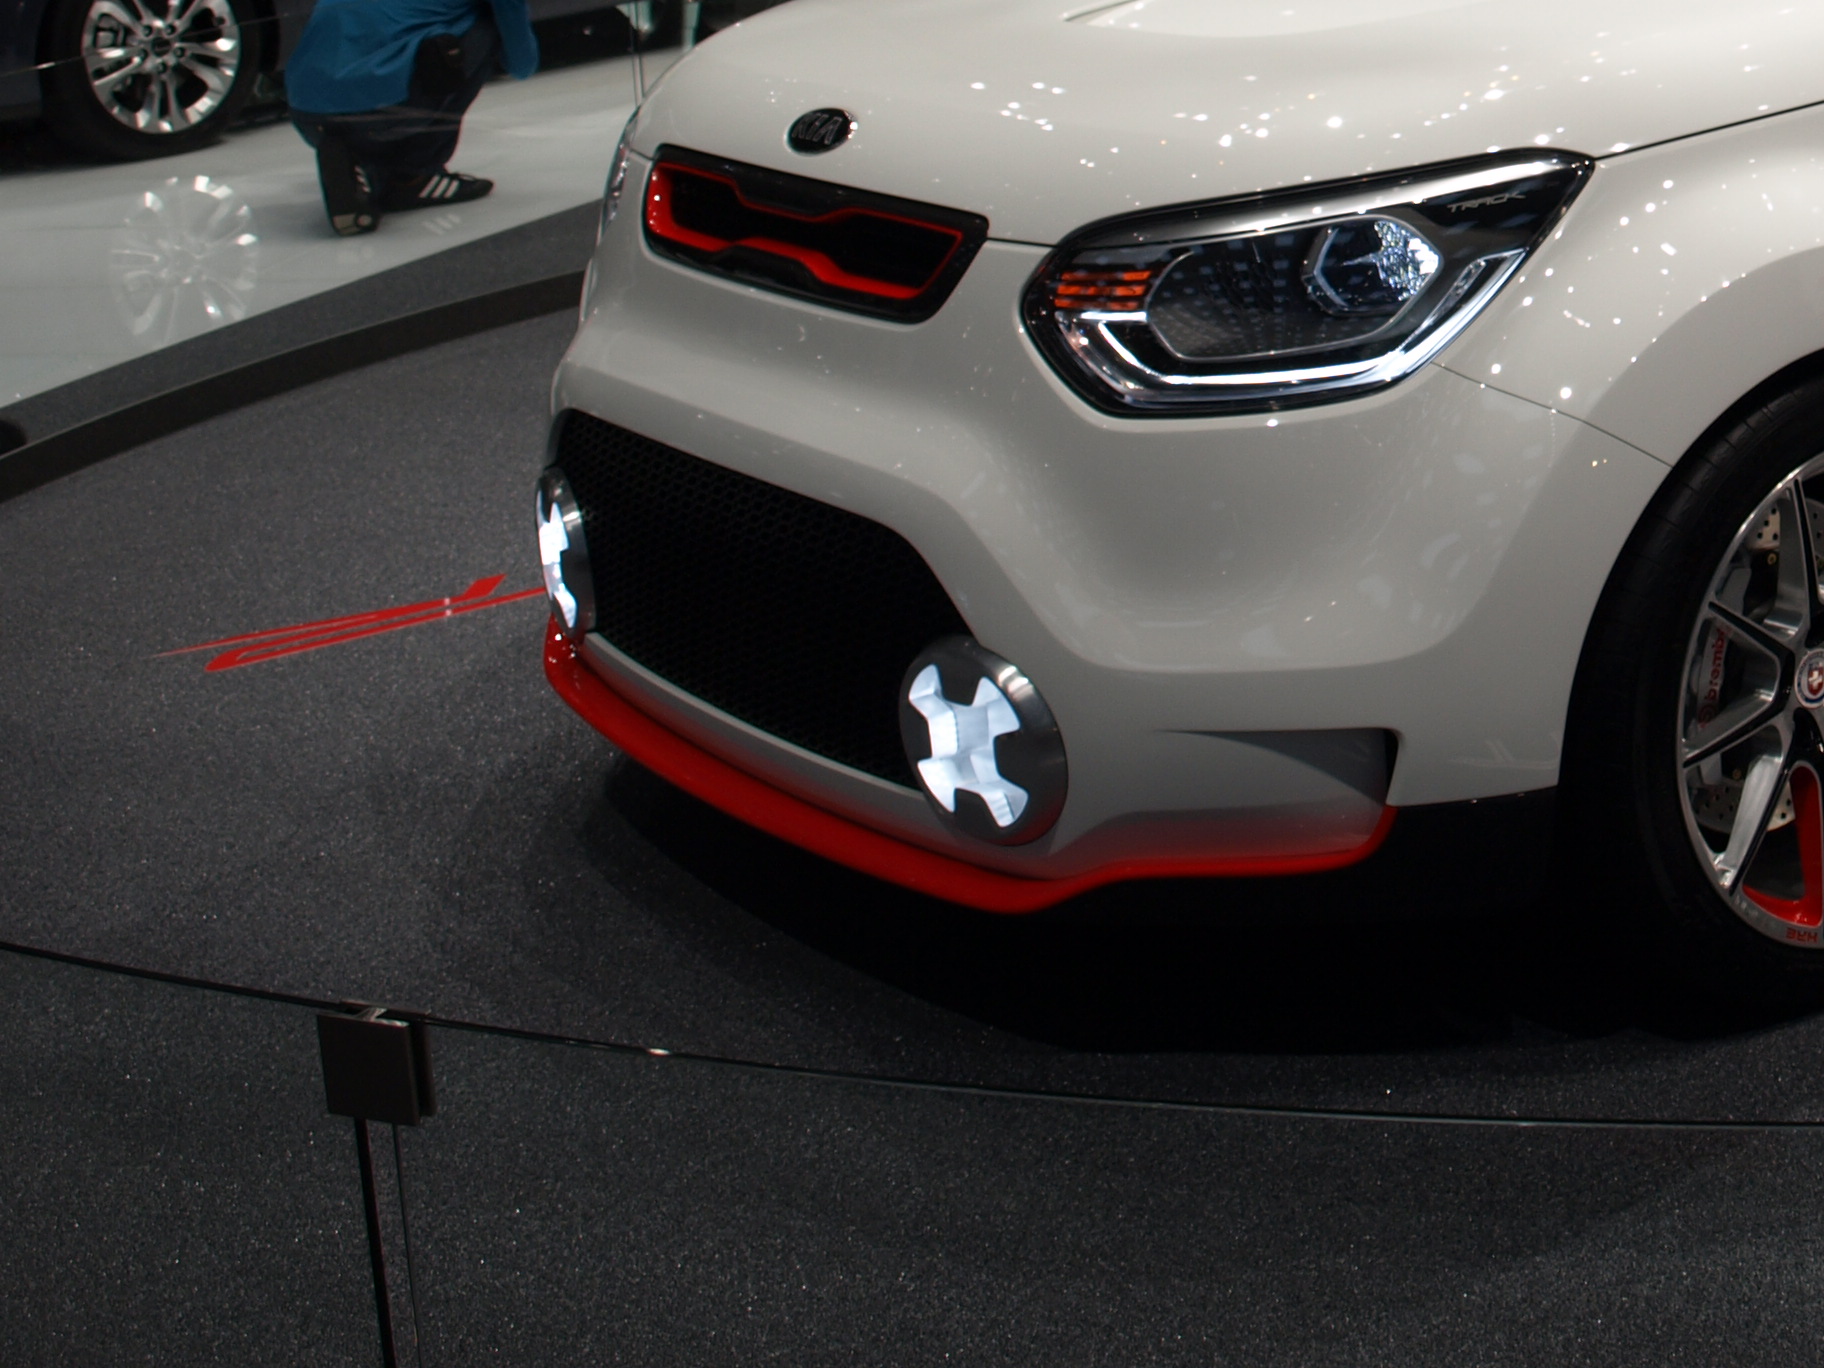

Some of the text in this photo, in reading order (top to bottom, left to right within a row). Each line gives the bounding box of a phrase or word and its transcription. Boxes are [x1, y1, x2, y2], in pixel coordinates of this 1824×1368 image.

[791, 113, 843, 145] KIA
[1447, 192, 1527, 213] TRACK
[1785, 928, 1819, 945] HRE
